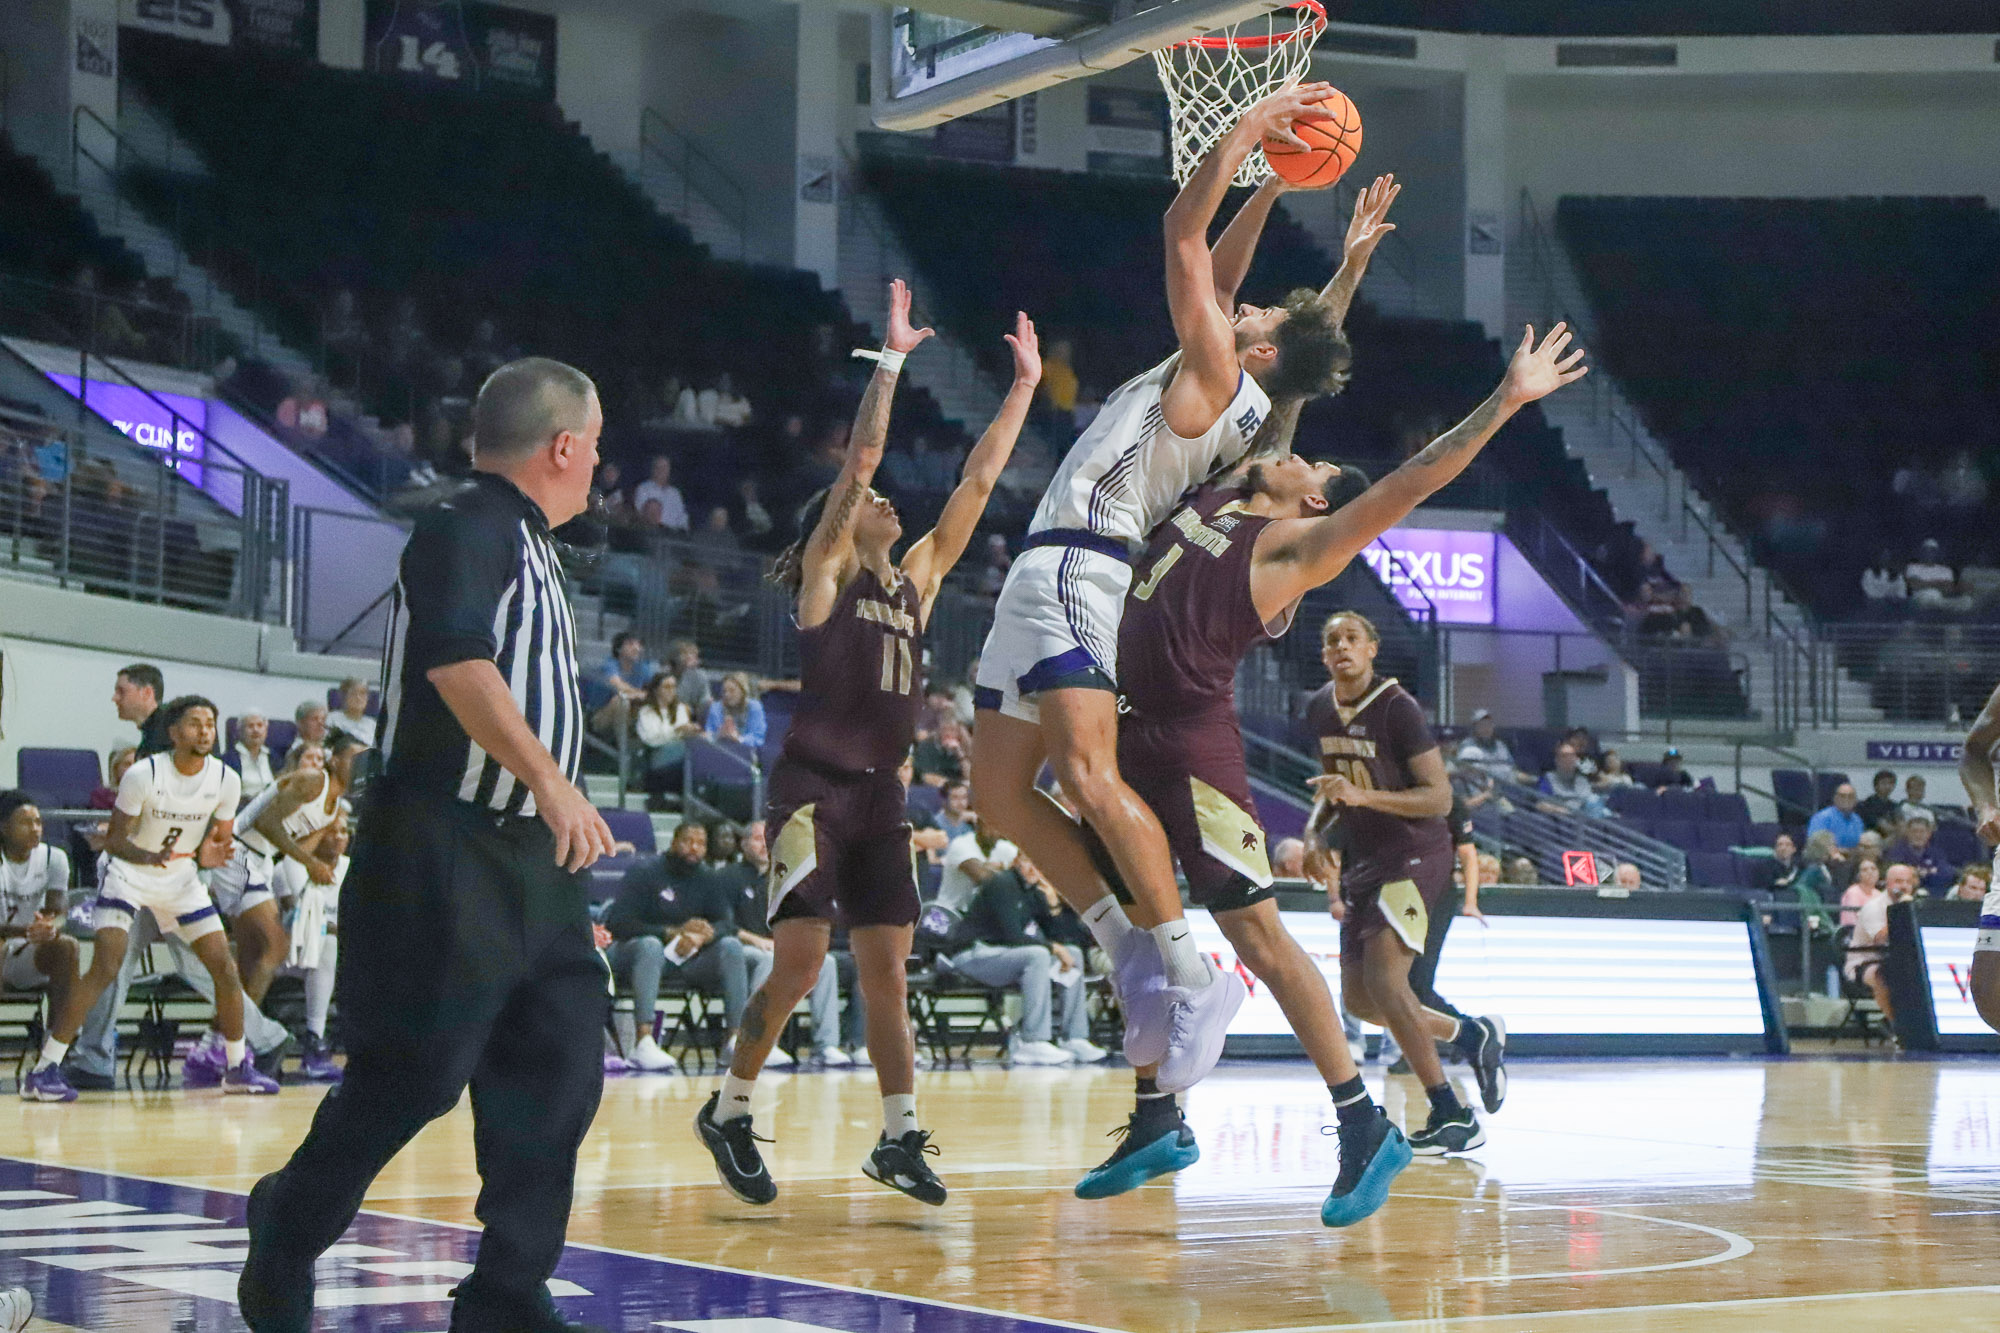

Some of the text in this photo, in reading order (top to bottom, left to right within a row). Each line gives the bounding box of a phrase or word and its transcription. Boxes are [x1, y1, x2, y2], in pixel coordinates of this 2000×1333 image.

[400, 35, 460, 79] 14
[135, 423, 195, 452] CLINIC
[881, 633, 913, 695] 11
